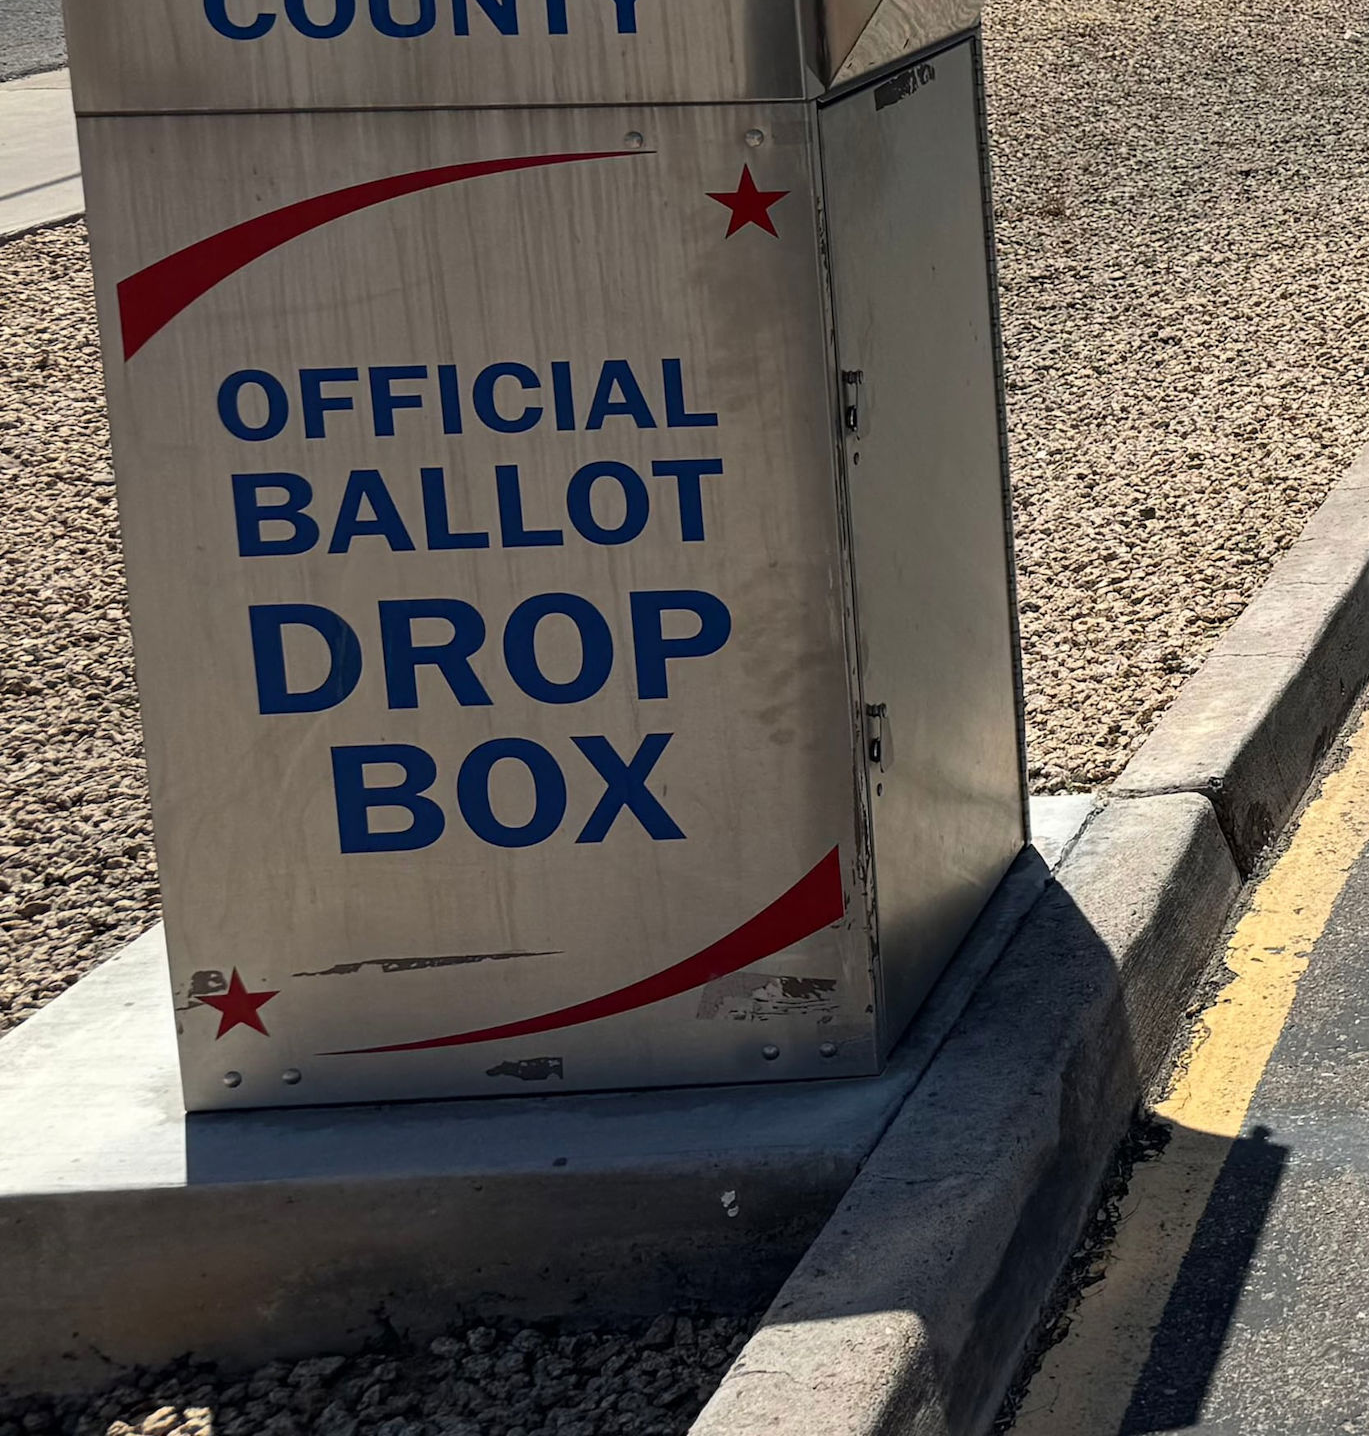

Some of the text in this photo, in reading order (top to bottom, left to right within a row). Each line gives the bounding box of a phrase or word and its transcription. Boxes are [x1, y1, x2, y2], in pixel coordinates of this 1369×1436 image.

[216, 358, 720, 441] OFFICIAL
[230, 458, 724, 557] BALLOT
[248, 590, 733, 715] DROP
[331, 733, 687, 854] BOX
